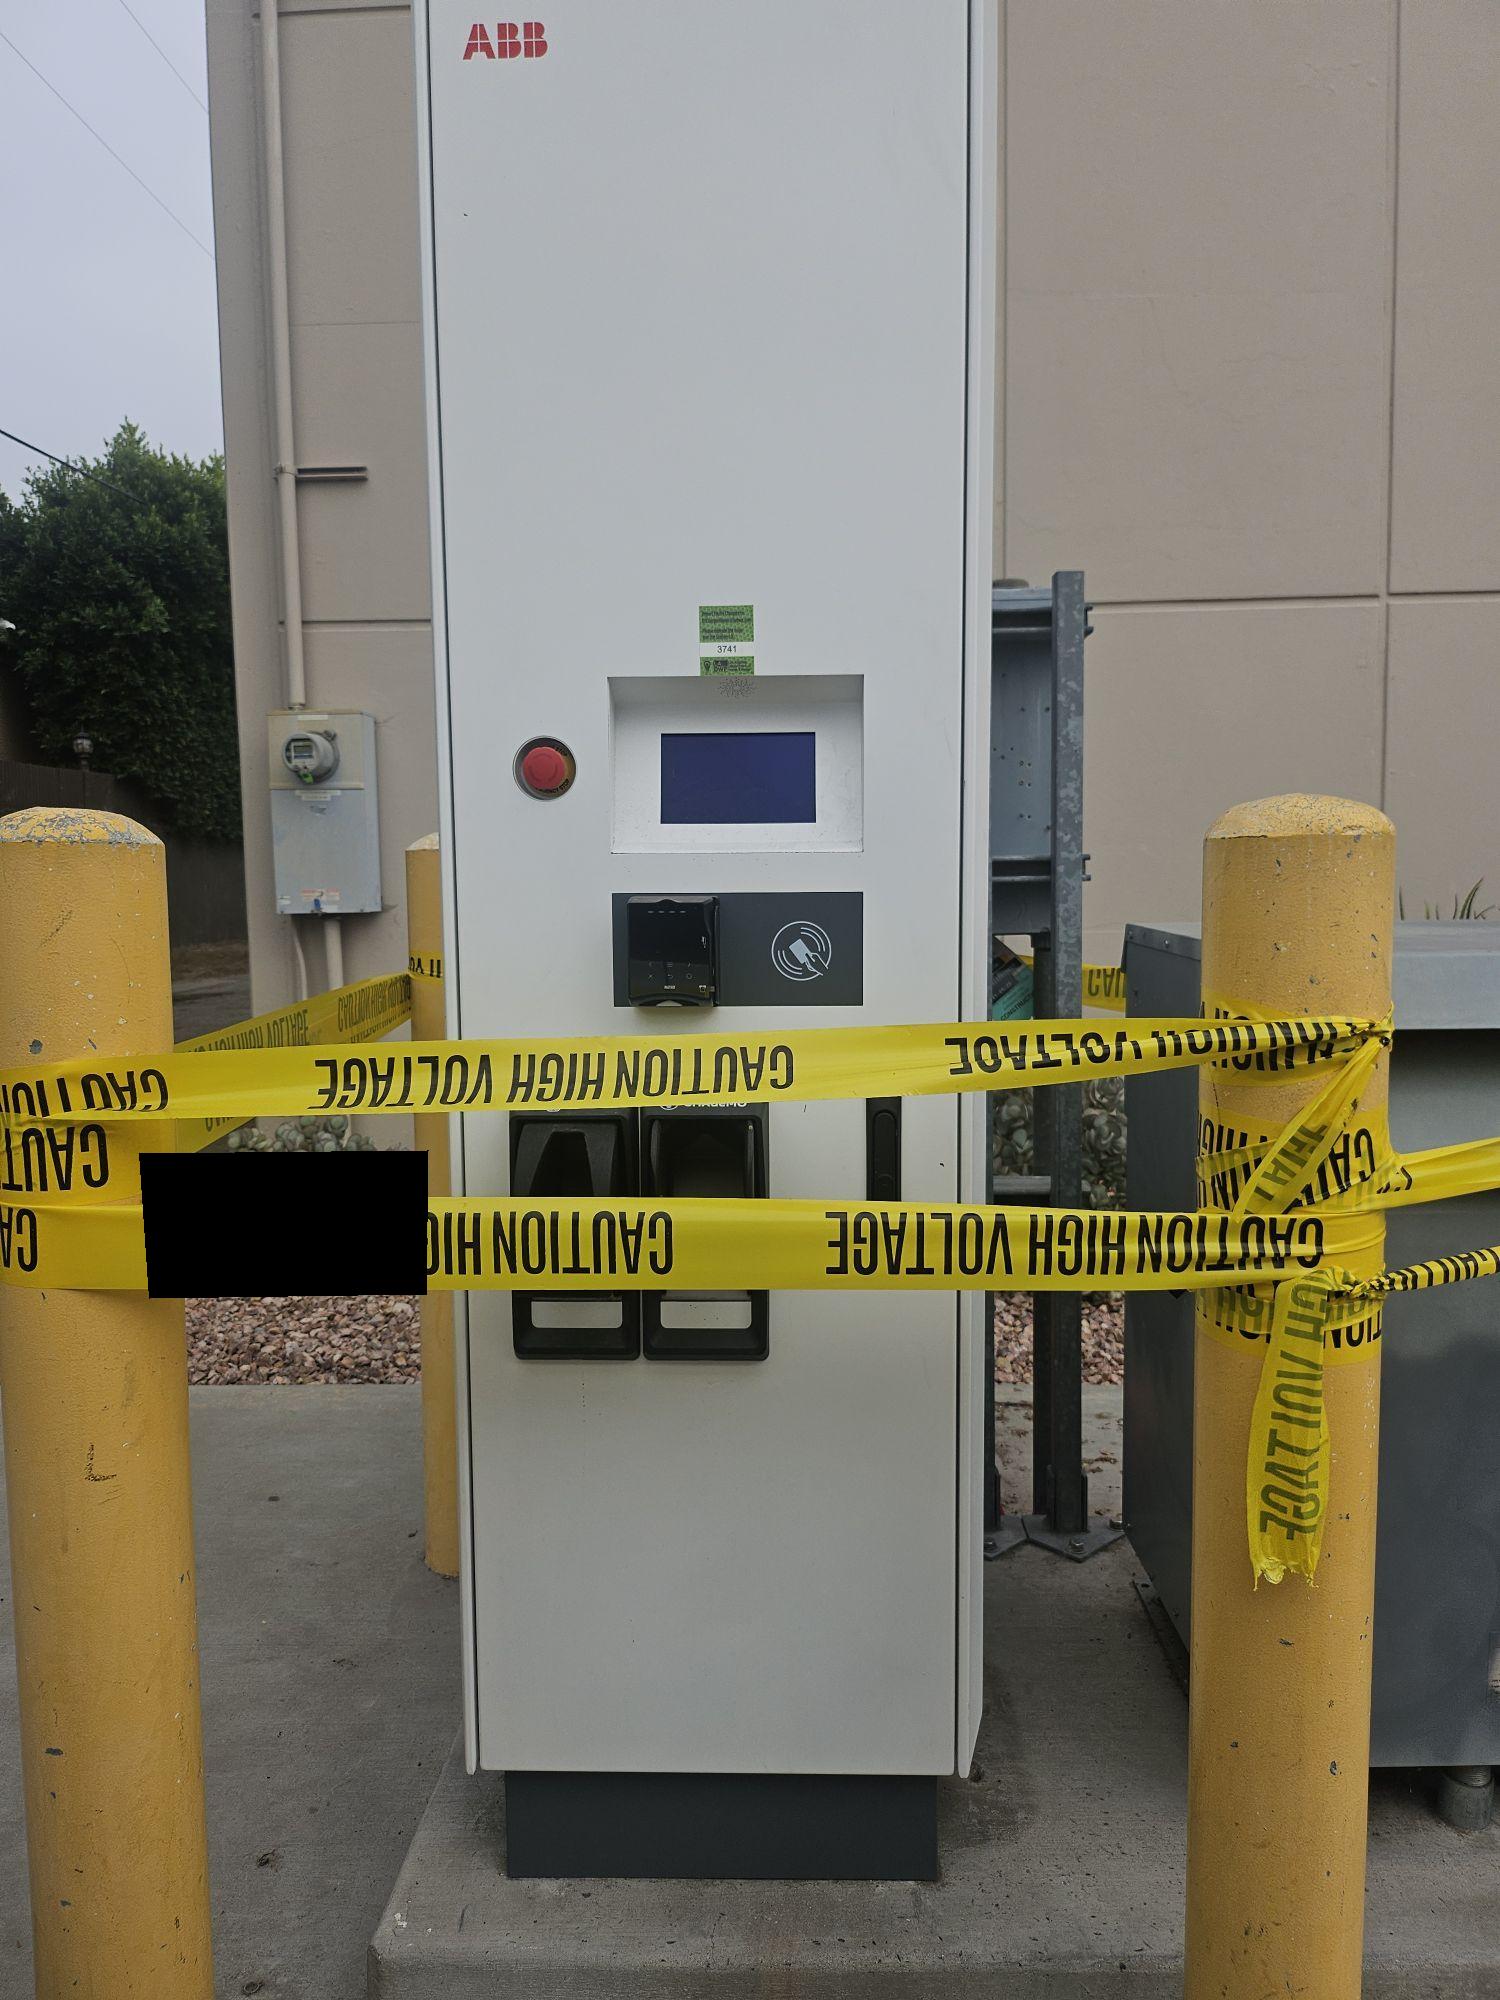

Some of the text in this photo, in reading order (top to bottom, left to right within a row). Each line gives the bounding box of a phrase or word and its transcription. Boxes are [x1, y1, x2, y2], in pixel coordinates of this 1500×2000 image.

[463, 22, 548, 60] ABB
[717, 645, 737, 654] 3741
[308, 1045, 794, 1109] CAUTION HIGH VOLTAGE
[494, 1211, 674, 1275] CAUTION
[825, 1211, 1324, 1276] CAUTION HIGH VOLTAGE
